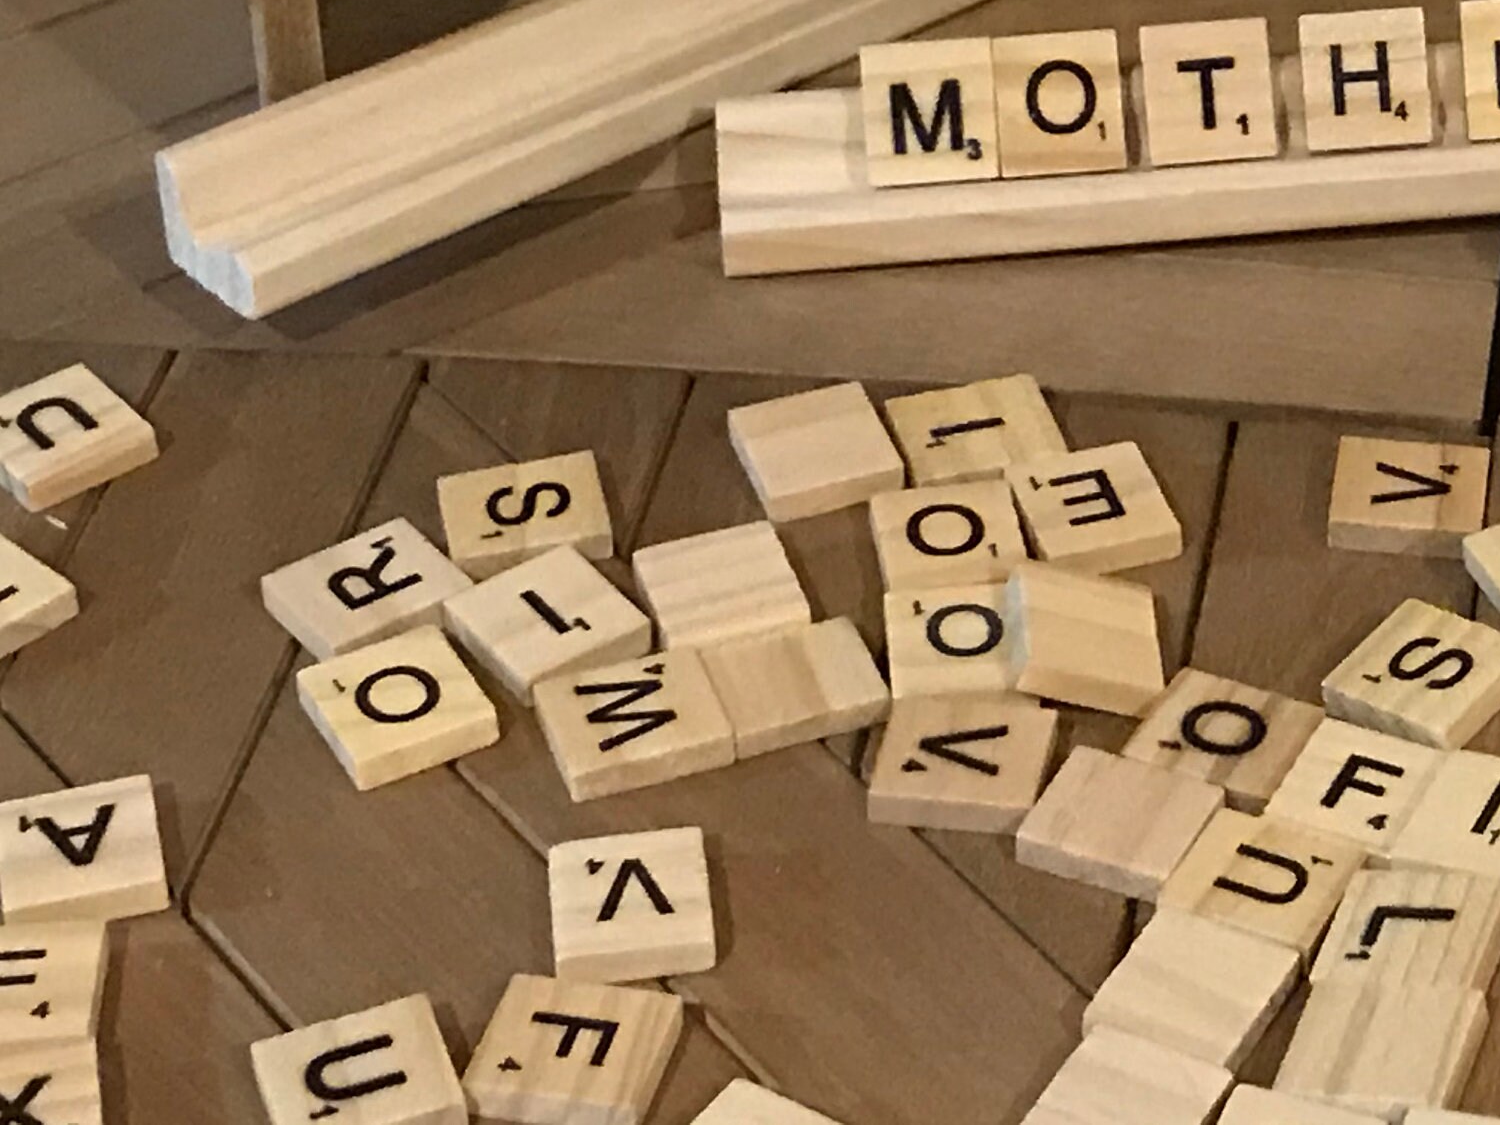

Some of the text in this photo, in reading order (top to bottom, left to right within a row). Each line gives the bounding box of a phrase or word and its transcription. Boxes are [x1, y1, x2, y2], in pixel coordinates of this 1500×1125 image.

[16, 397, 99, 450] U
[485, 482, 571, 526] S
[1048, 469, 1126, 526] E
[1371, 462, 1451, 505] V
[906, 504, 985, 556] O
[328, 546, 422, 610] R
[926, 604, 1003, 657] O
[1388, 637, 1474, 690] S
[355, 666, 441, 723] O
[573, 679, 677, 752] W
[918, 725, 1009, 776] V
[1180, 701, 1268, 756] O
[1320, 754, 1404, 808] F
[34, 804, 115, 866] A
[596, 858, 675, 922] V
[1213, 843, 1308, 904] U
[1360, 905, 1456, 947] L
[304, 1034, 407, 1100] U
[531, 1012, 620, 1067] F
